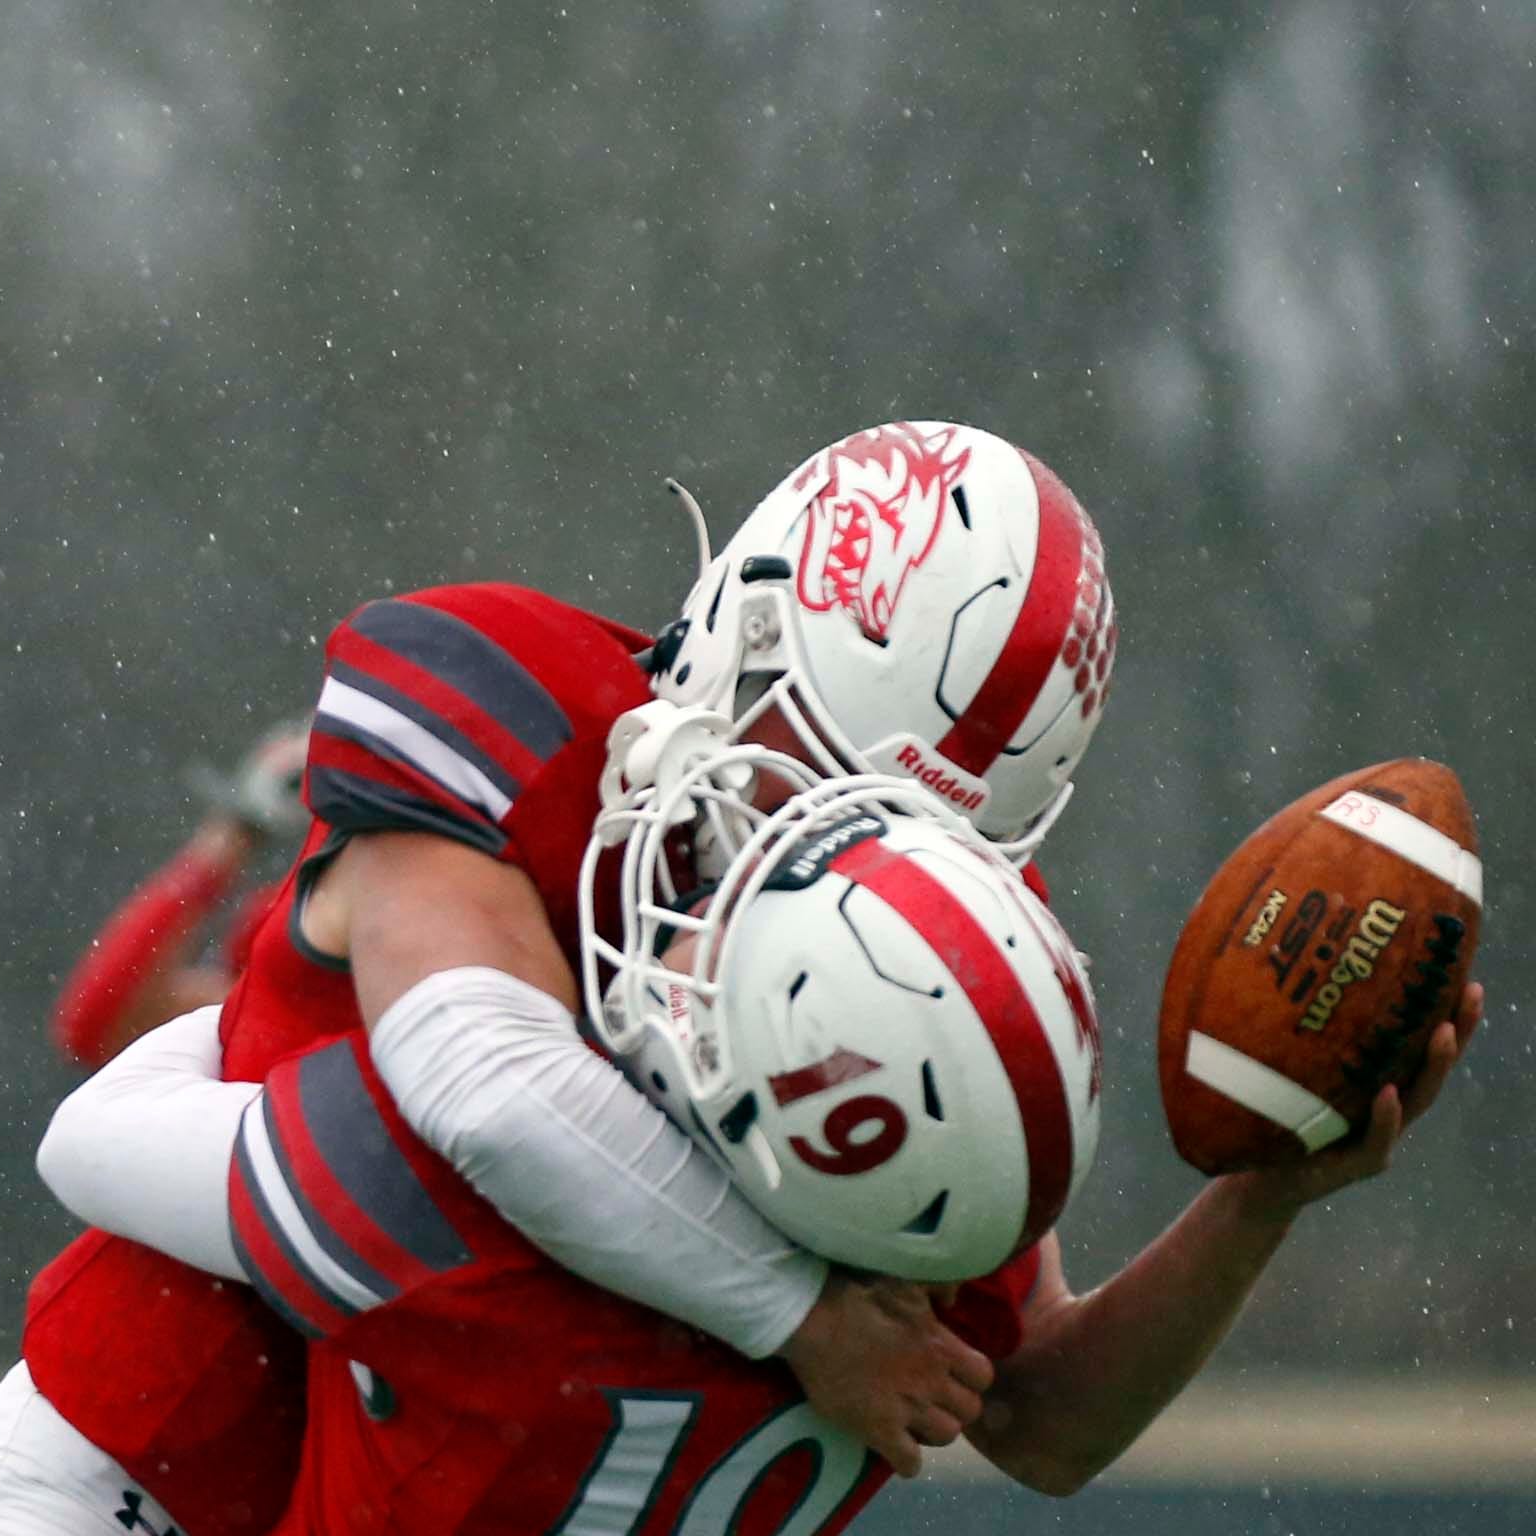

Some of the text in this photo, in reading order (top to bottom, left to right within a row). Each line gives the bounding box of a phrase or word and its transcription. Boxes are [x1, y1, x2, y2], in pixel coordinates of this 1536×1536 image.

[895, 743, 986, 811] Riddell
[1243, 889, 1288, 946] NCAA
[1299, 898, 1406, 1032] Wilson
[767, 1046, 909, 1177] 19
